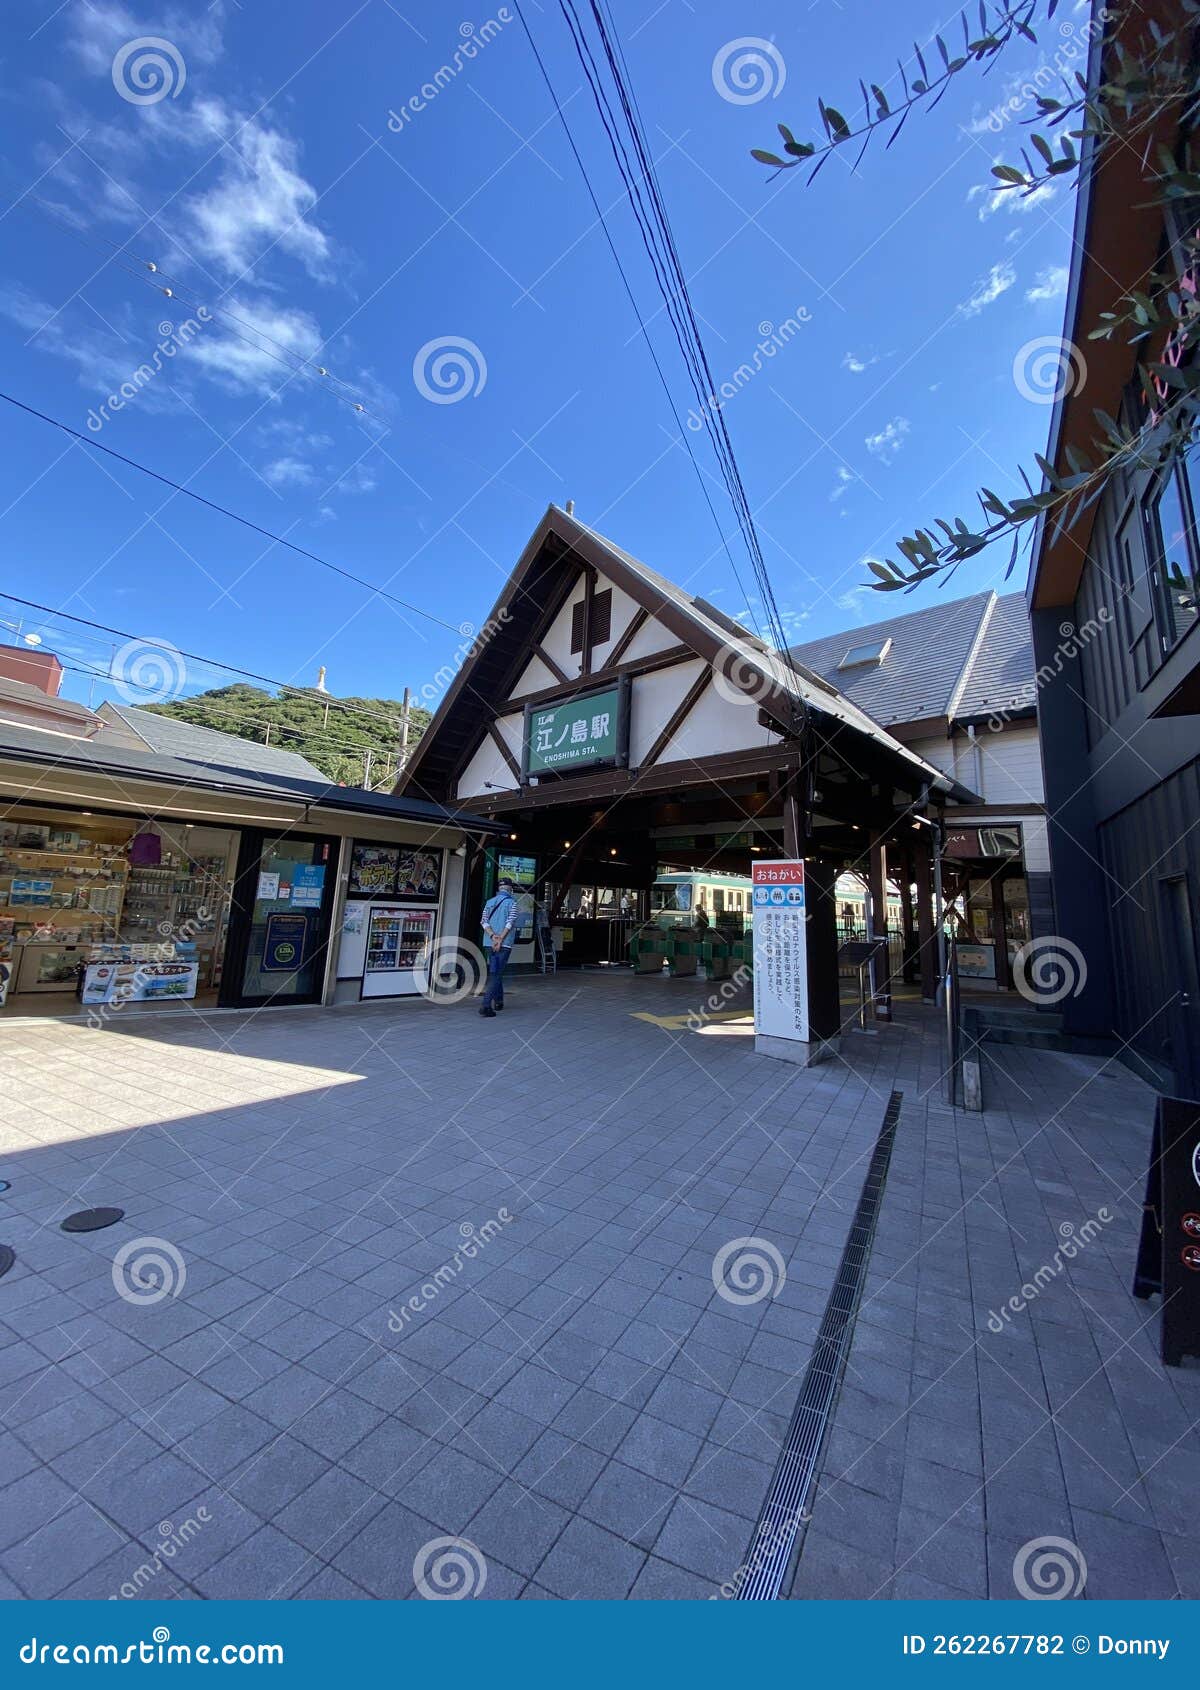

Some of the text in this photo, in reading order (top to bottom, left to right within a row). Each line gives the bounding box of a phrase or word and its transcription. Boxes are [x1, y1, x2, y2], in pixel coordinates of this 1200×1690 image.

[536, 713, 609, 752] 江ノ島駅
[544, 746, 598, 763] ENOSHIMA STA.
[757, 869, 801, 881] おねがい
[783, 913, 792, 995] おいの距離を保つなど、
